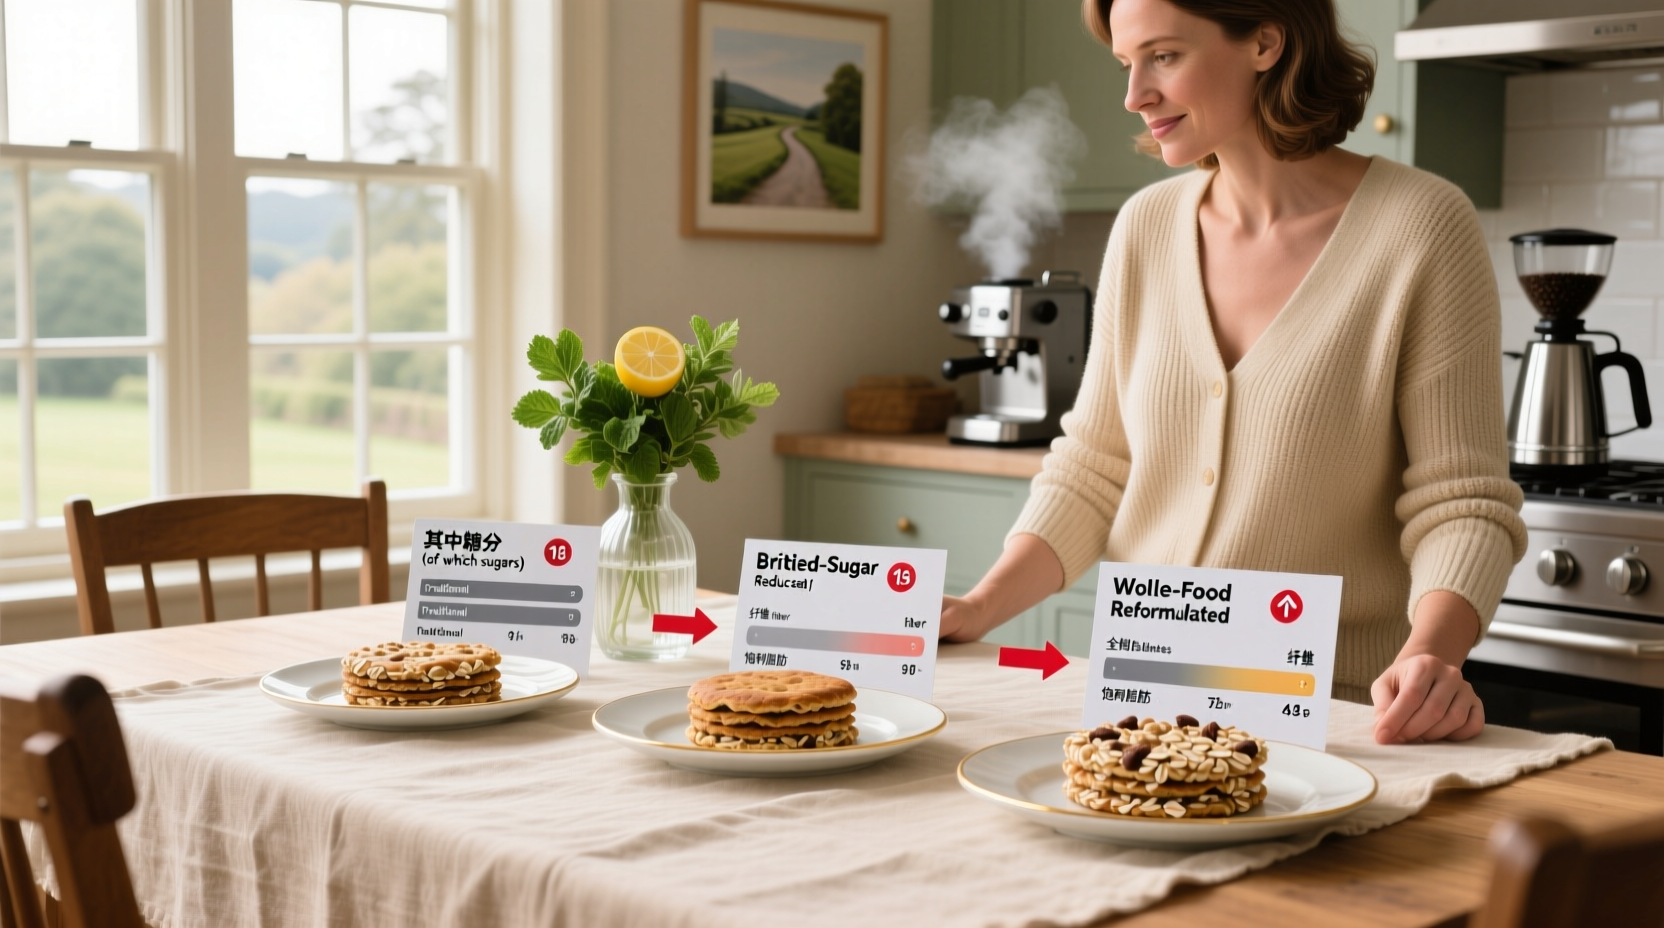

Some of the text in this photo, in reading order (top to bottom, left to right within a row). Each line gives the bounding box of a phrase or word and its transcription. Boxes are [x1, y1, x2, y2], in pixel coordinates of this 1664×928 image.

[421, 552, 525, 572] (of which sugars)
[1113, 577, 1232, 602] Wolle-Food
[1110, 600, 1231, 624] Reformulated
